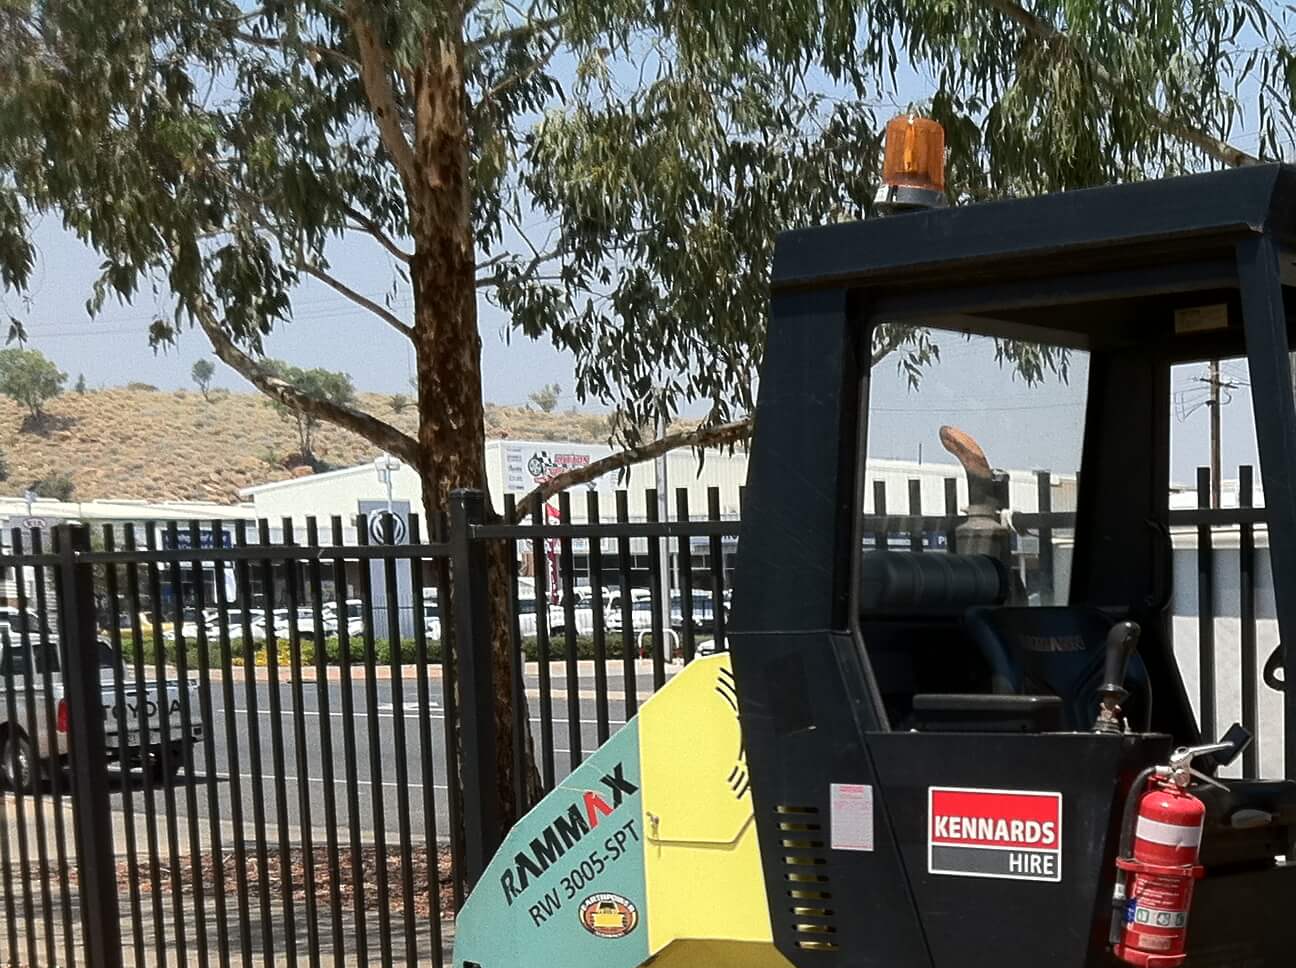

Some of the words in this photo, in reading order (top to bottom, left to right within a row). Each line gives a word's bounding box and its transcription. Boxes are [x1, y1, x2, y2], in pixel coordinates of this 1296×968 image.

[500, 761, 639, 907] RAMMAX
[934, 815, 1056, 844] KENNARDS
[1008, 852, 1055, 875] HIRE
[528, 887, 562, 928] RW
[560, 818, 640, 900] 3005-SPT
